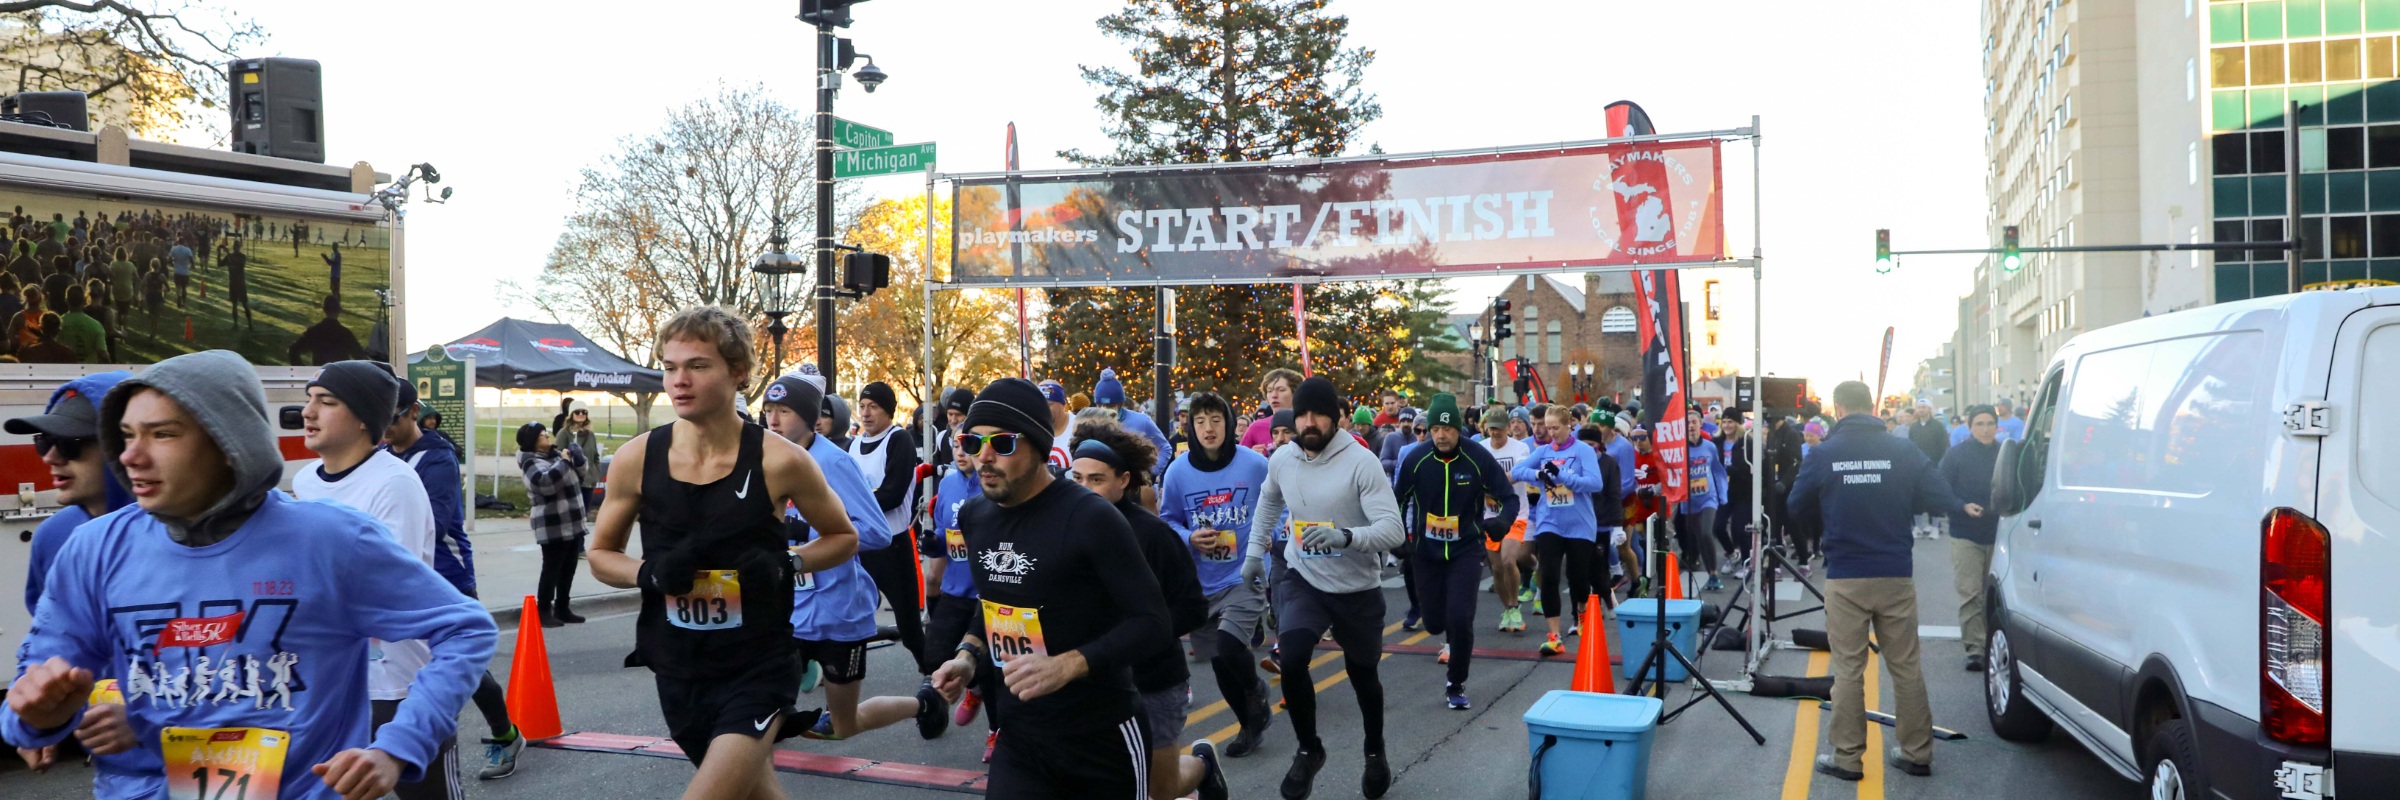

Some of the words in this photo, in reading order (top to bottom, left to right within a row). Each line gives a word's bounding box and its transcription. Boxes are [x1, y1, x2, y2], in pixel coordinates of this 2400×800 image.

[845, 122, 880, 148] Capitol
[836, 153, 843, 162] W
[847, 151, 917, 173] Michigan
[921, 144, 935, 154] Ave
[1592, 151, 1694, 192] PLAYMAKERS
[1117, 189, 1555, 254] START/FINISH
[1589, 205, 1622, 252] LOCAL
[1627, 238, 1678, 256] SINCE
[1678, 200, 1699, 237] 1981
[958, 225, 1098, 250] playmakers
[574, 369, 633, 388] playmakers
[1832, 460, 1863, 472] MICHIGAN
[1863, 459, 1891, 470] RUNNING
[1843, 473, 1882, 484] FOUNDATION
[1430, 526, 1454, 540] 446
[998, 541, 1014, 551] RUN
[988, 573, 1023, 585] DANSVILLE
[676, 596, 728, 625] 803
[201, 621, 228, 644] 5K
[192, 766, 251, 800] 171
